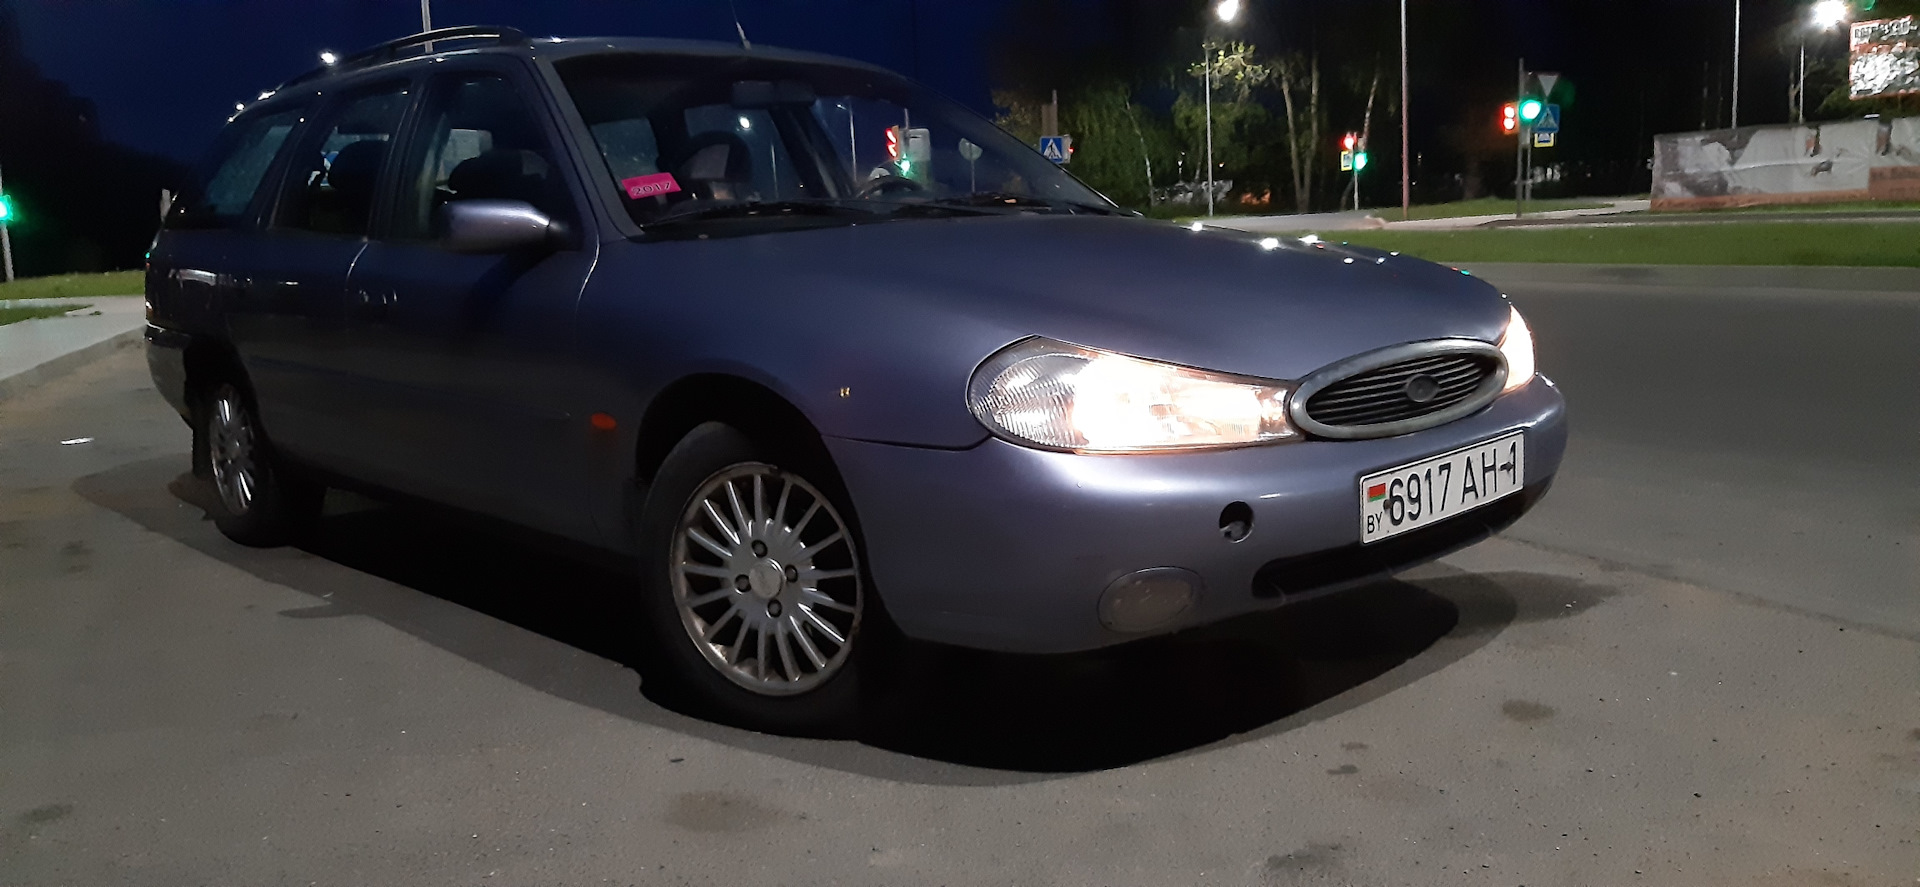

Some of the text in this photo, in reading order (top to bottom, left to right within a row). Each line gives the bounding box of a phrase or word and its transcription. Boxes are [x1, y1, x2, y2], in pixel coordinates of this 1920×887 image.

[632, 181, 671, 196] 2017
[1389, 461, 1452, 526] 6917
[1367, 511, 1382, 534] BY
